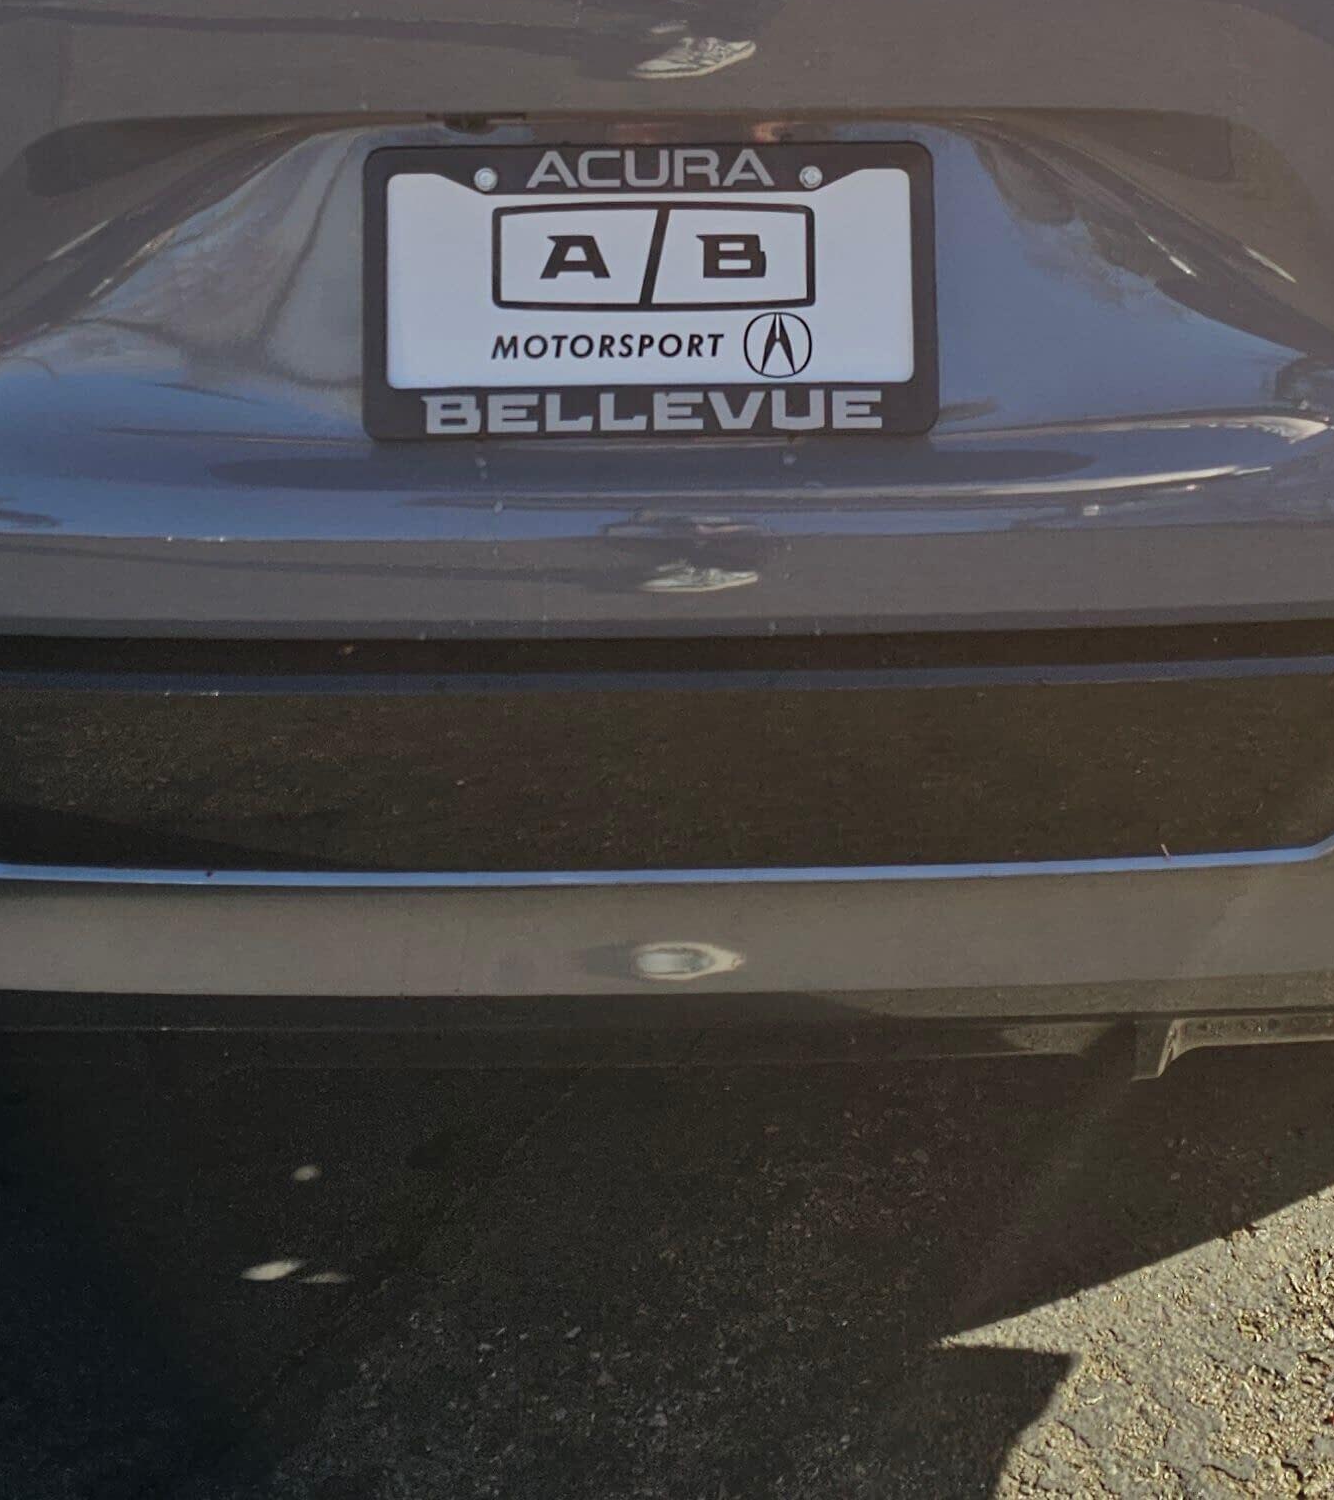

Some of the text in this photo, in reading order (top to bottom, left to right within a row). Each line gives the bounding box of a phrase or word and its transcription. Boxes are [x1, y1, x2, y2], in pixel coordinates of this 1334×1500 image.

[526, 149, 775, 189] ACURA
[491, 333, 724, 360] MOTORSPORT
[420, 390, 883, 435] BELLEVUE
